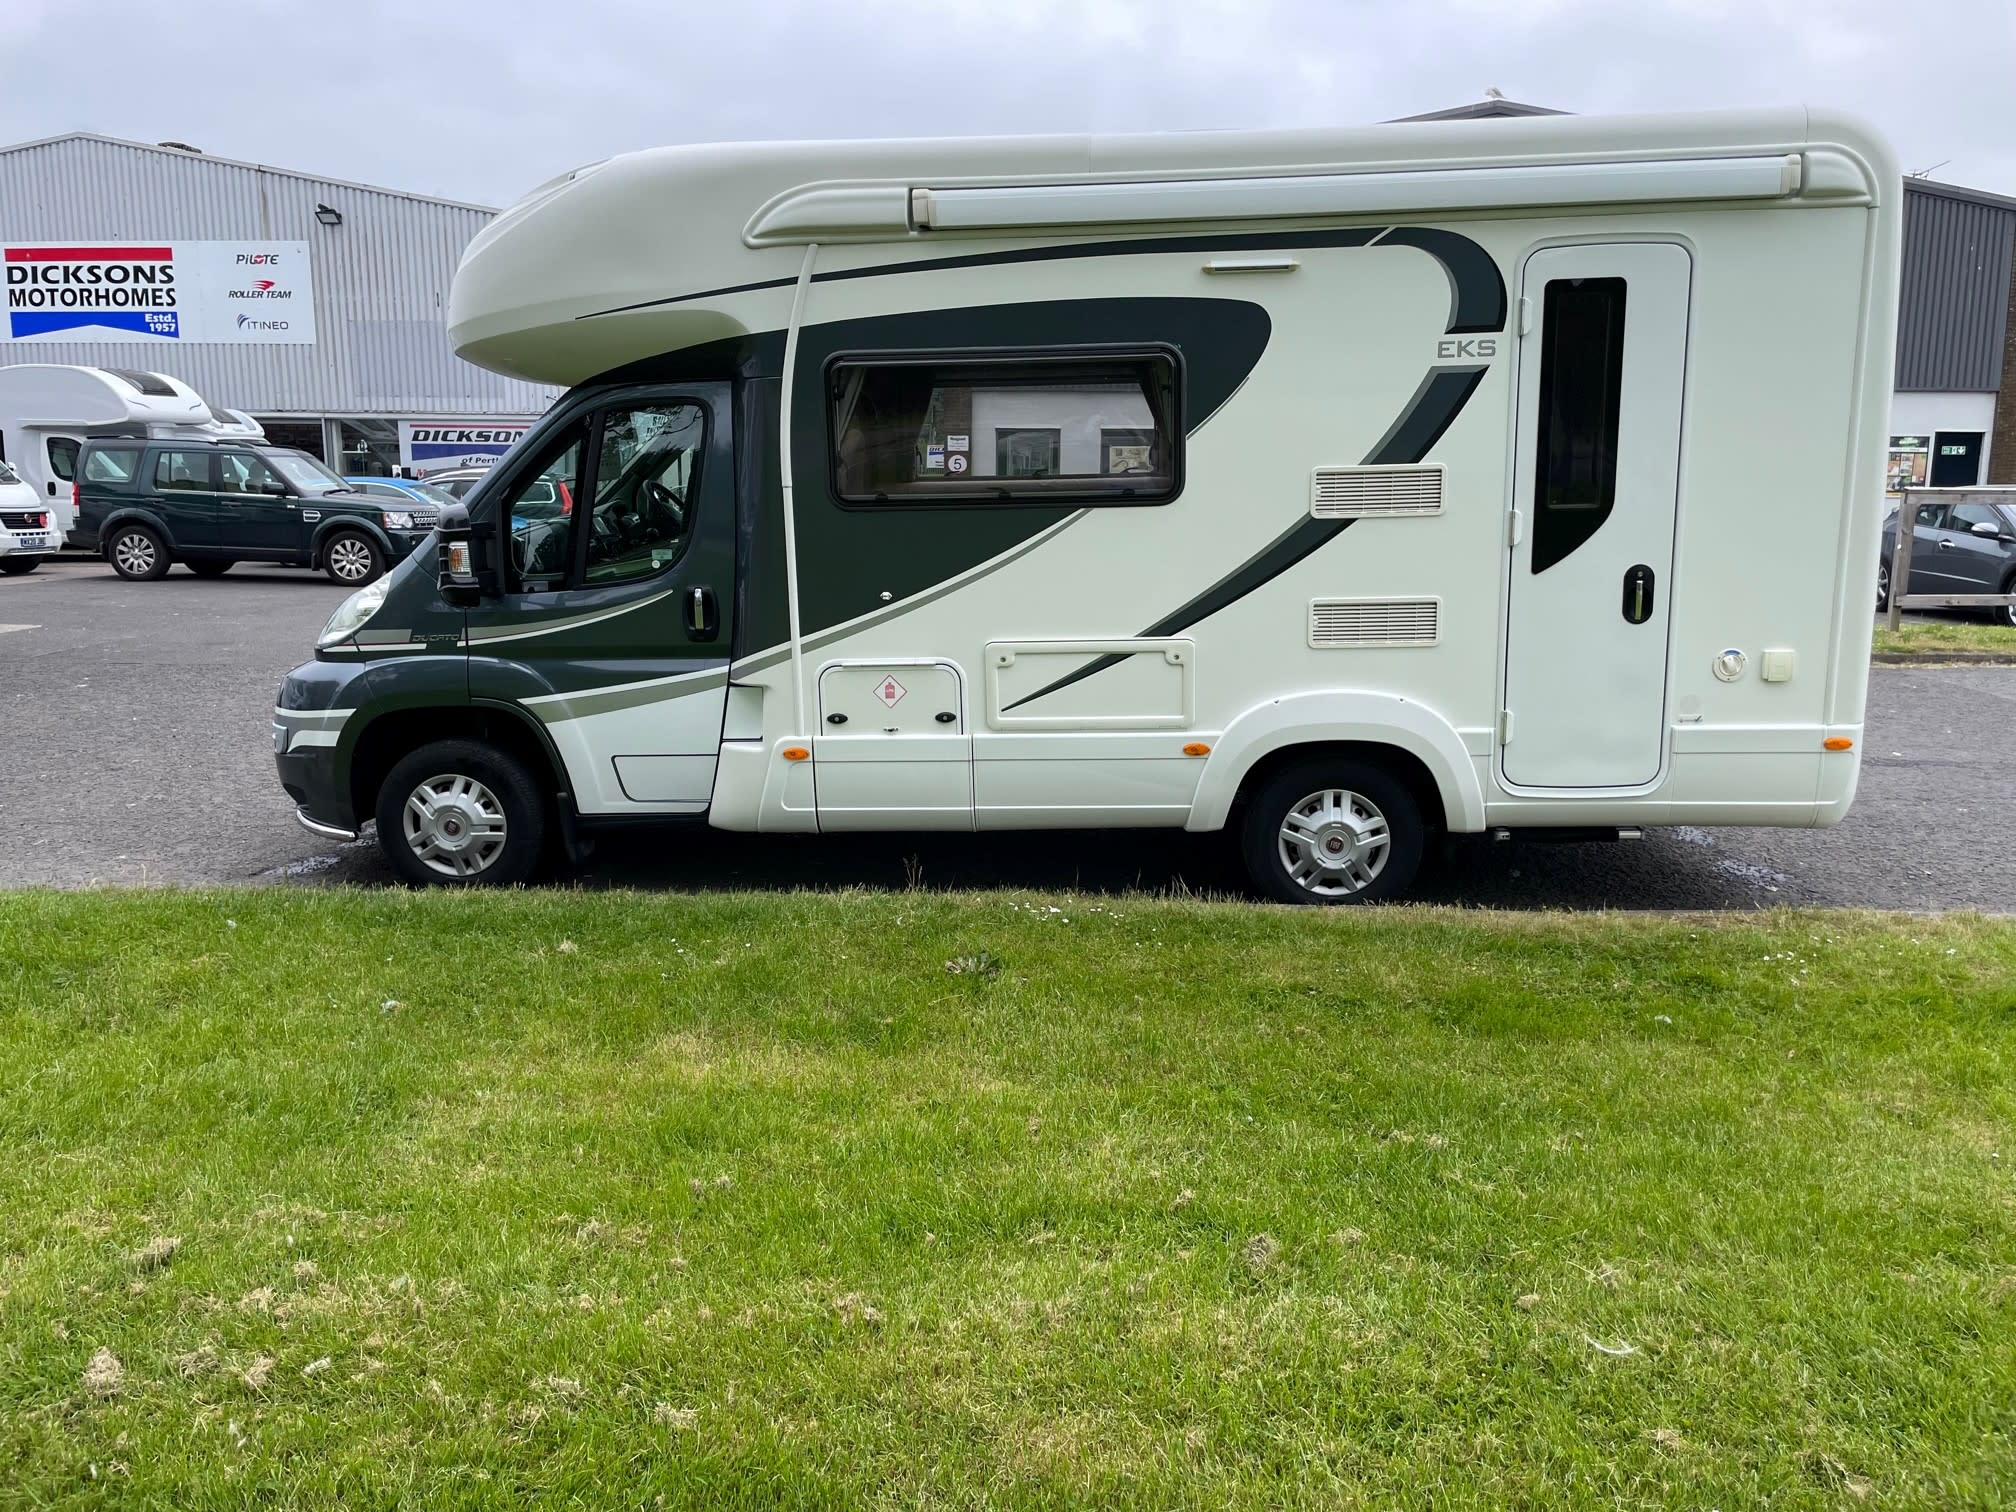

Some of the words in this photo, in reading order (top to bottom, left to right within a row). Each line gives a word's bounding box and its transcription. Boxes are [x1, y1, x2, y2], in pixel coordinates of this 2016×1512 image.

[6, 265, 175, 285] DICKSONS
[8, 287, 177, 307] MOTORHOMES
[228, 290, 264, 299] ROLLER
[266, 290, 292, 299] TEAM
[144, 313, 176, 323] Estd.
[149, 323, 176, 332] 1957
[247, 321, 289, 330] ITINEO
[1437, 339, 1496, 358] EKS
[953, 458, 962, 470] 5
